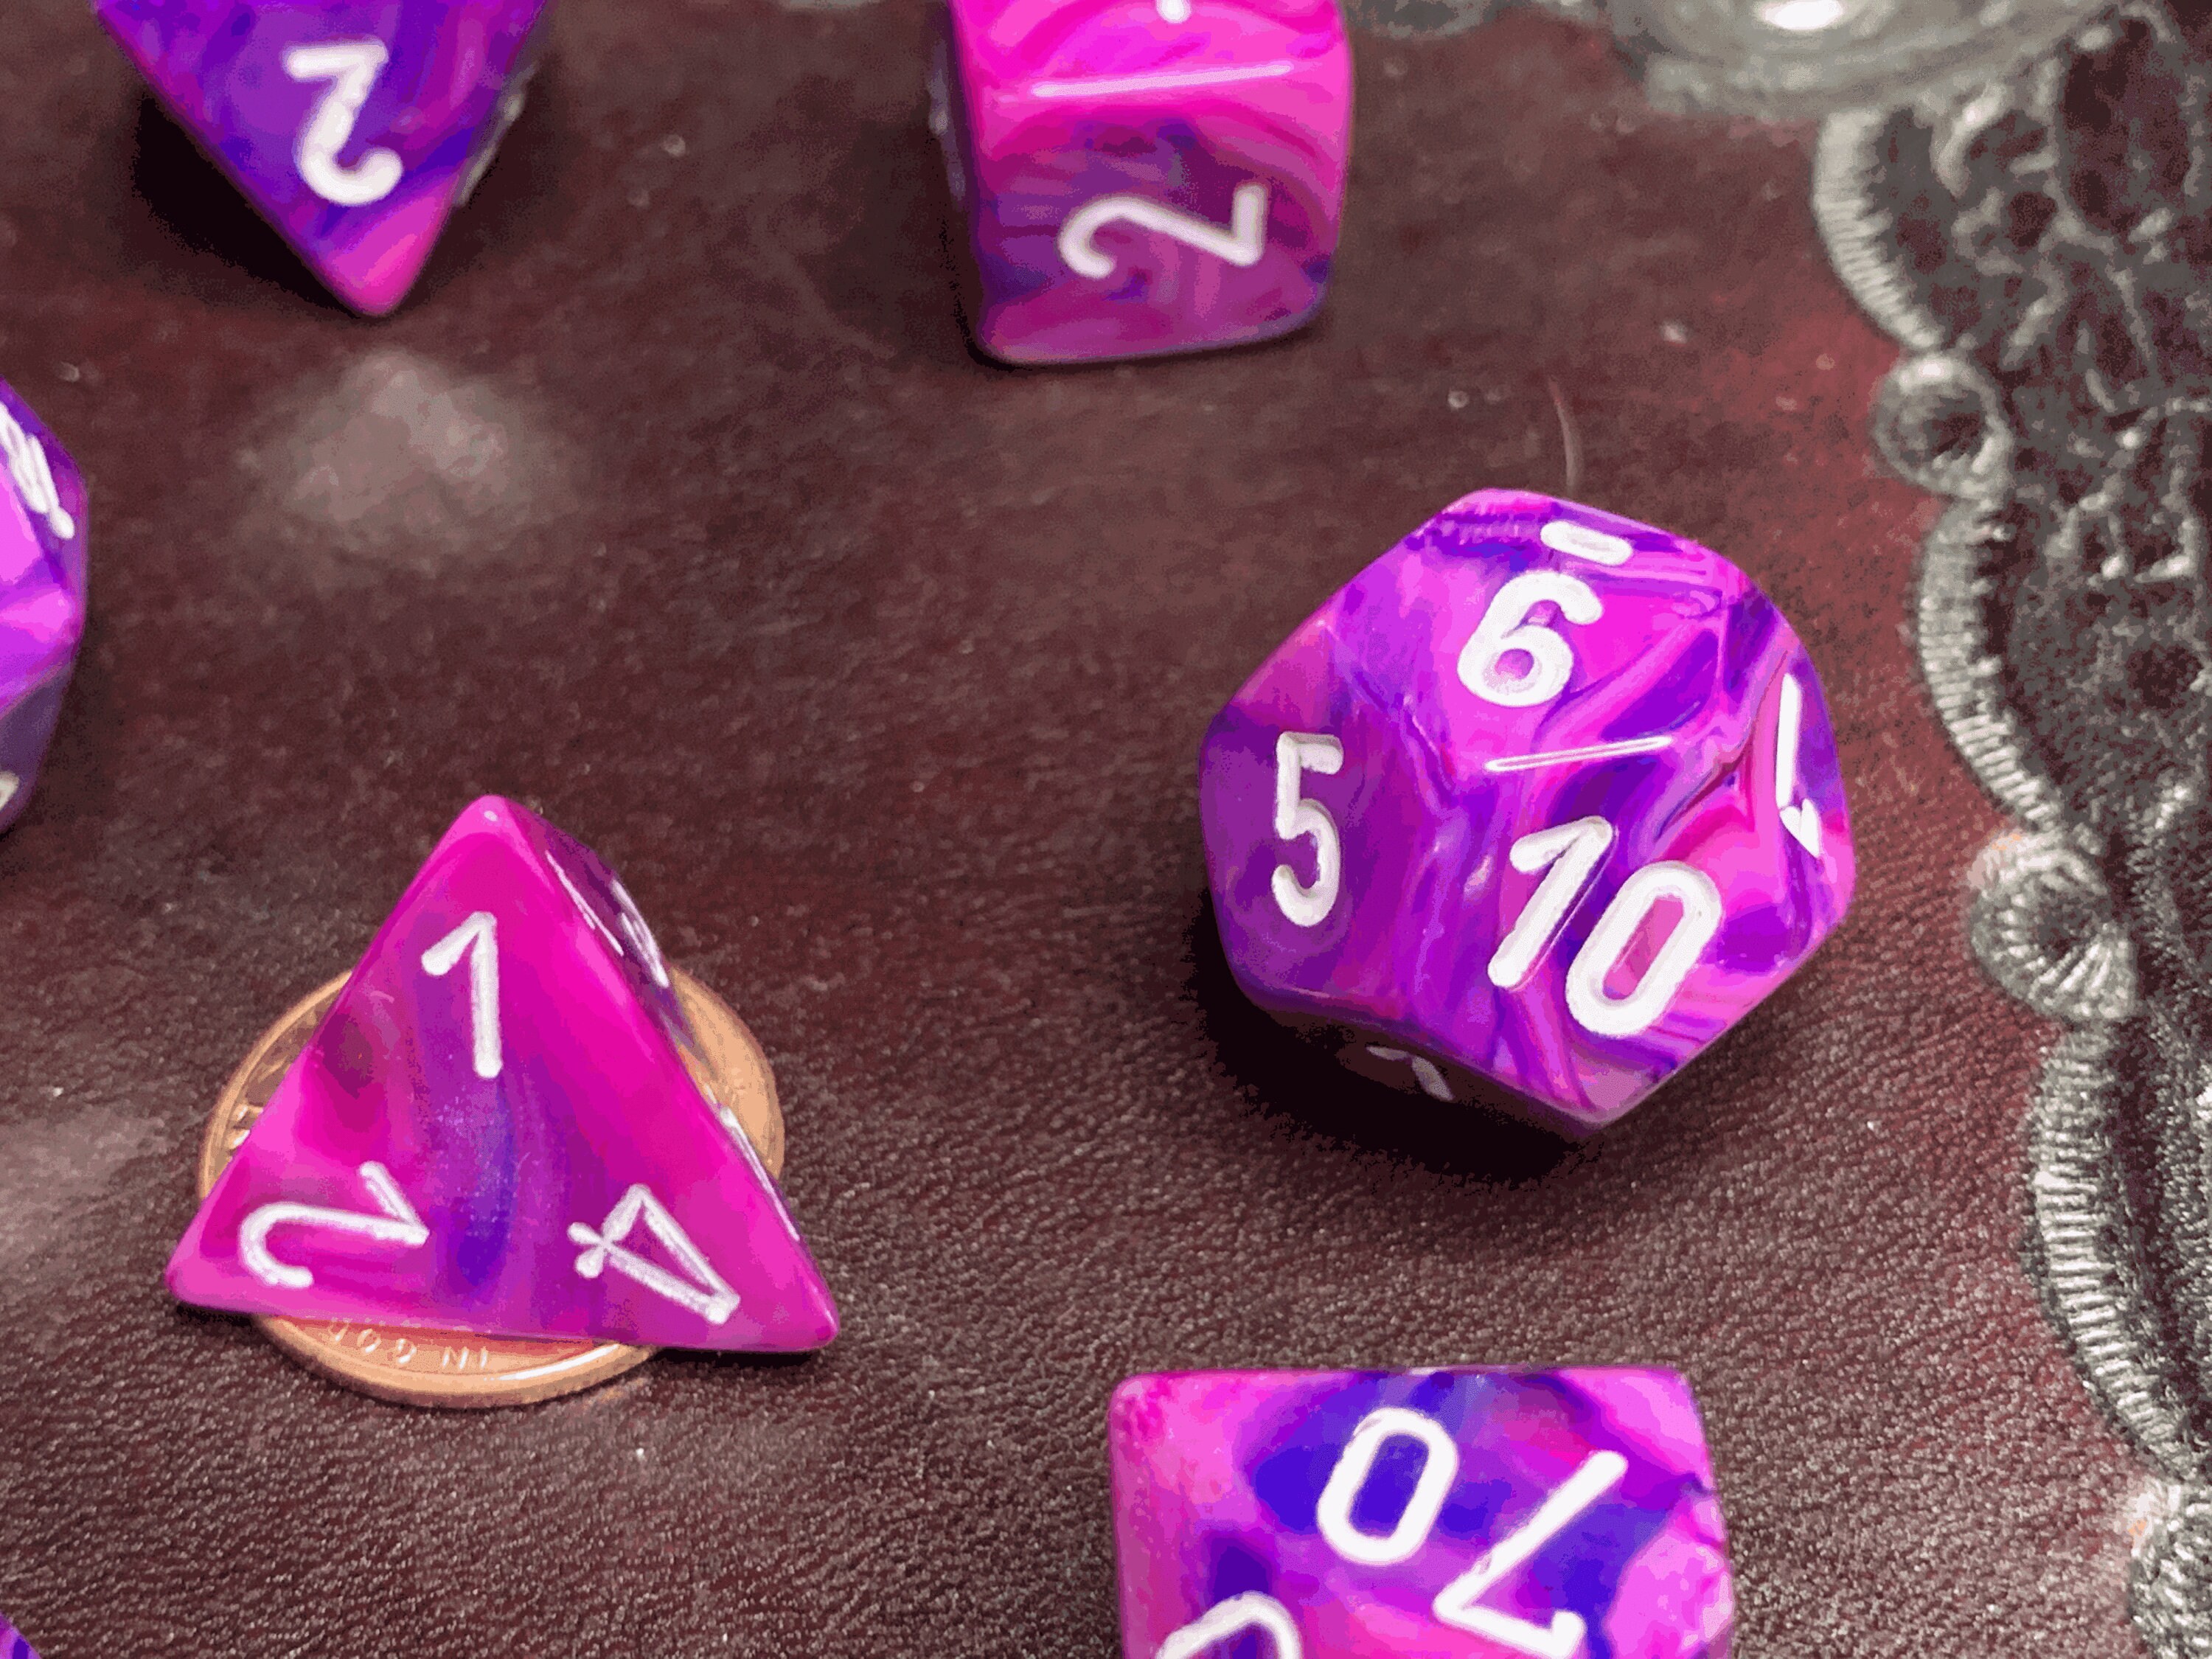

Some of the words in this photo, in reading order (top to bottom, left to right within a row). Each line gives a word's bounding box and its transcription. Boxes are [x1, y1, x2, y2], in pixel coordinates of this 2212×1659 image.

[283, 38, 404, 206] 2
[1057, 183, 1270, 280] 2
[1456, 570, 1604, 708] 6
[1270, 731, 1345, 928] 5
[420, 911, 503, 1079] 1
[1486, 814, 1723, 1038] 10
[240, 1161, 431, 1289] 2
[567, 1183, 740, 1325] 4
